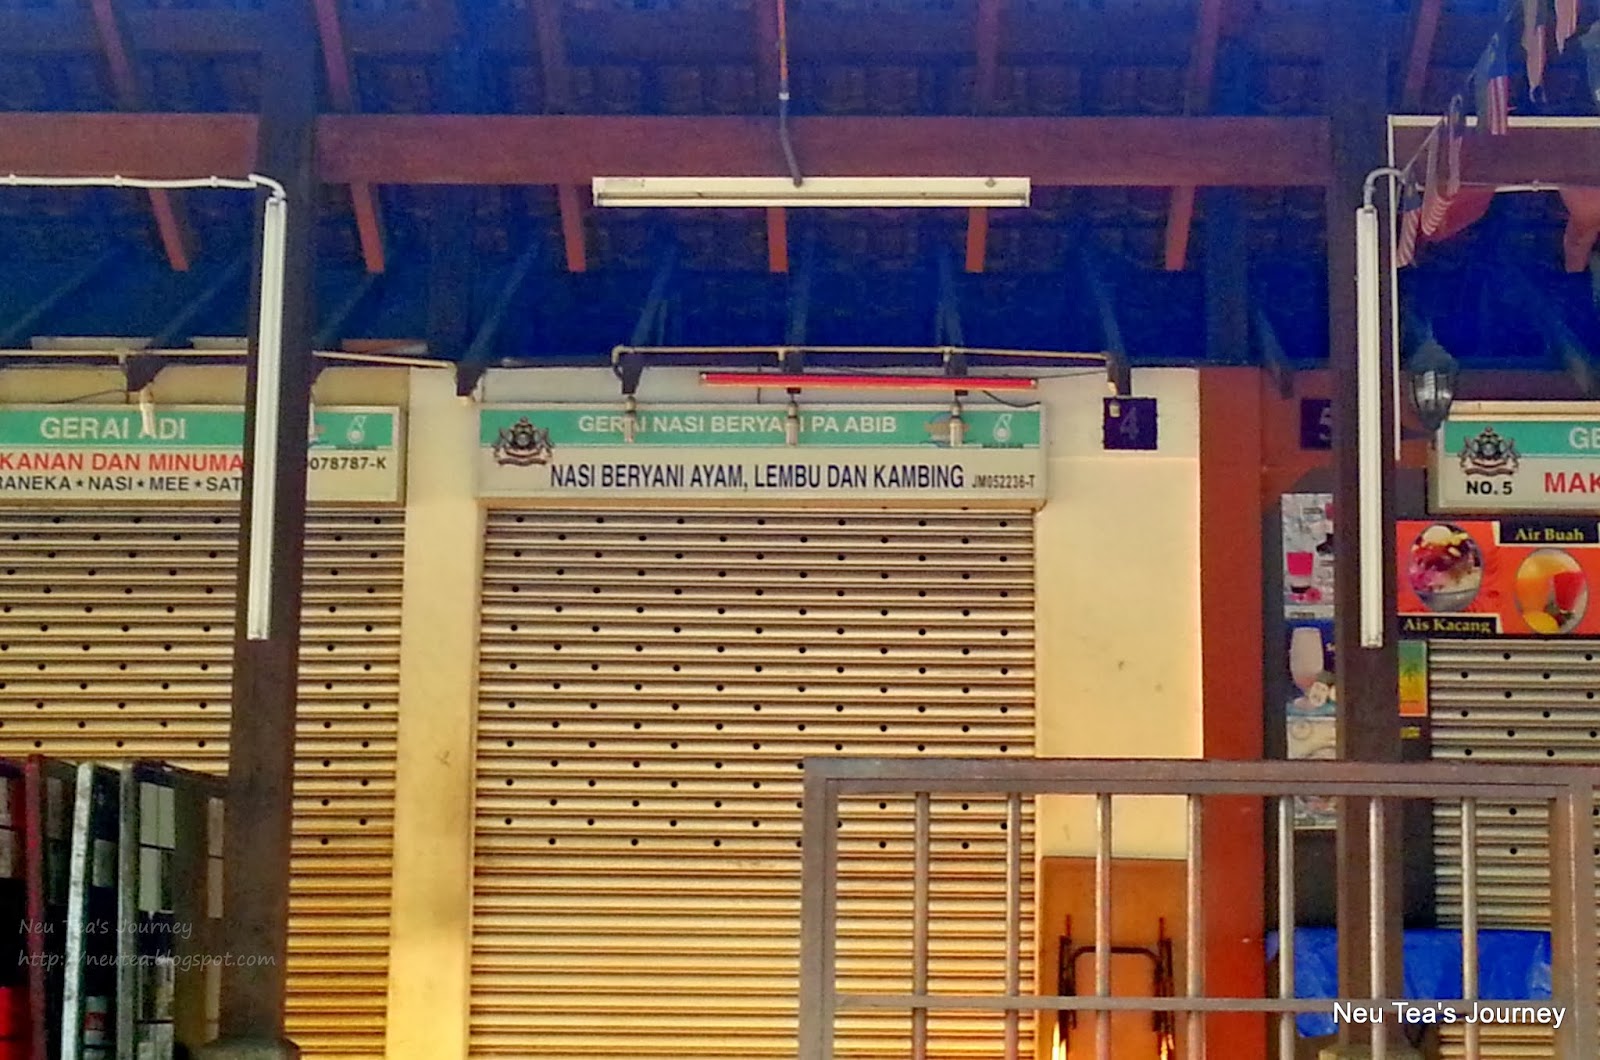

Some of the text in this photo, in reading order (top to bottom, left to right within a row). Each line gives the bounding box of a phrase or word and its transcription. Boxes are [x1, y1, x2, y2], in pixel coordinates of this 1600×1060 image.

[40, 417, 129, 440] GERAI
[653, 416, 704, 433] NASI
[711, 415, 805, 433] BERYAI
[812, 416, 840, 433] PA
[844, 416, 897, 433] ABIB
[1119, 407, 1140, 440] 4
[0, 452, 84, 470] KANAN
[92, 453, 141, 471] DAN
[0, 476, 72, 490] ANEKA
[88, 476, 134, 491] NASI
[150, 477, 190, 491] MEE
[551, 464, 595, 487] NASI
[602, 464, 684, 487] BERYANI
[755, 464, 820, 488] LEMBU
[828, 464, 867, 488] DAN
[874, 464, 964, 488] KAMBING
[1515, 528, 1584, 542] Air Buah
[1403, 618, 1491, 634] Ais Kacang
